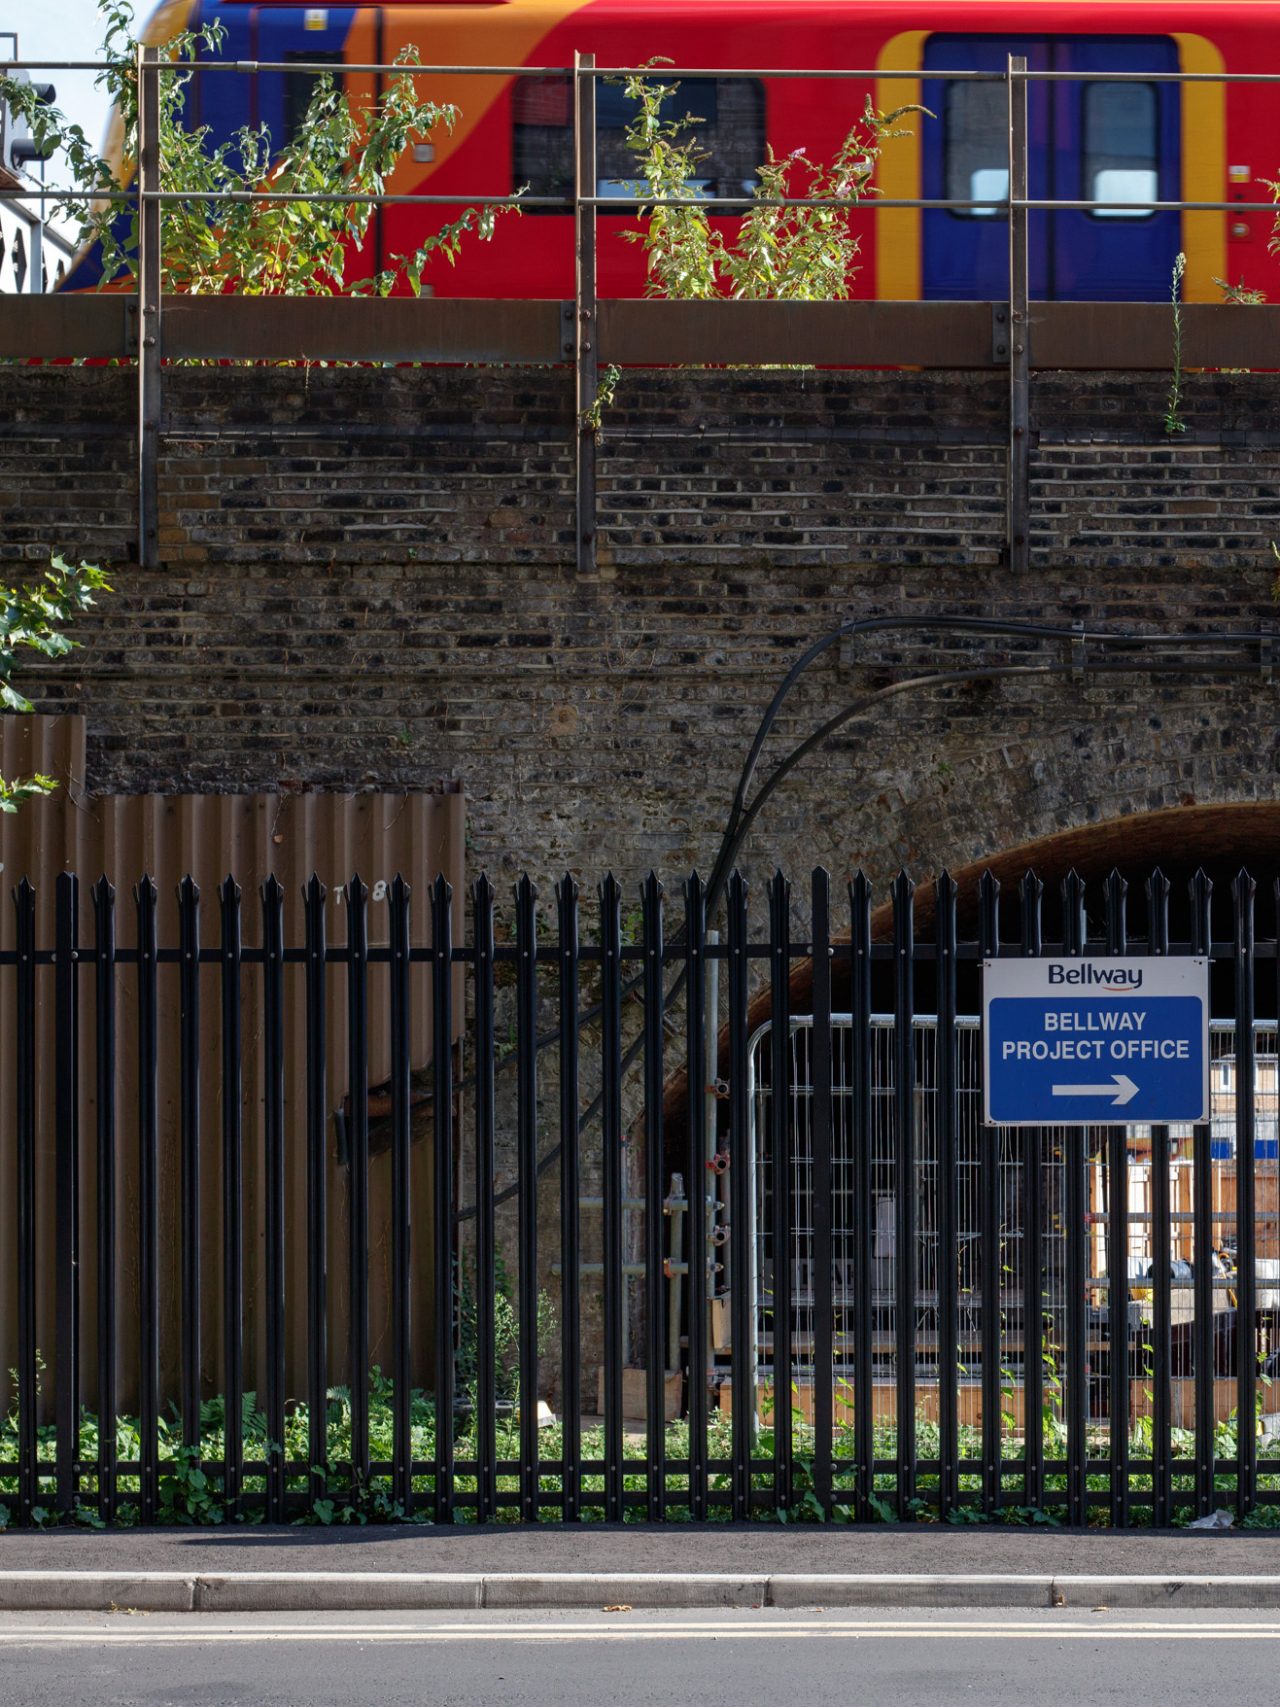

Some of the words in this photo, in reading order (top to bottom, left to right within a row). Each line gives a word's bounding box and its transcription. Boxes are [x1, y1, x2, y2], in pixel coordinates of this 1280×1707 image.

[1048, 963, 1143, 989] Bellway
[1044, 1012, 1146, 1031] BELLWAY
[1002, 1040, 1105, 1060] PROJECT
[1110, 1039, 1190, 1059] OFFICE
